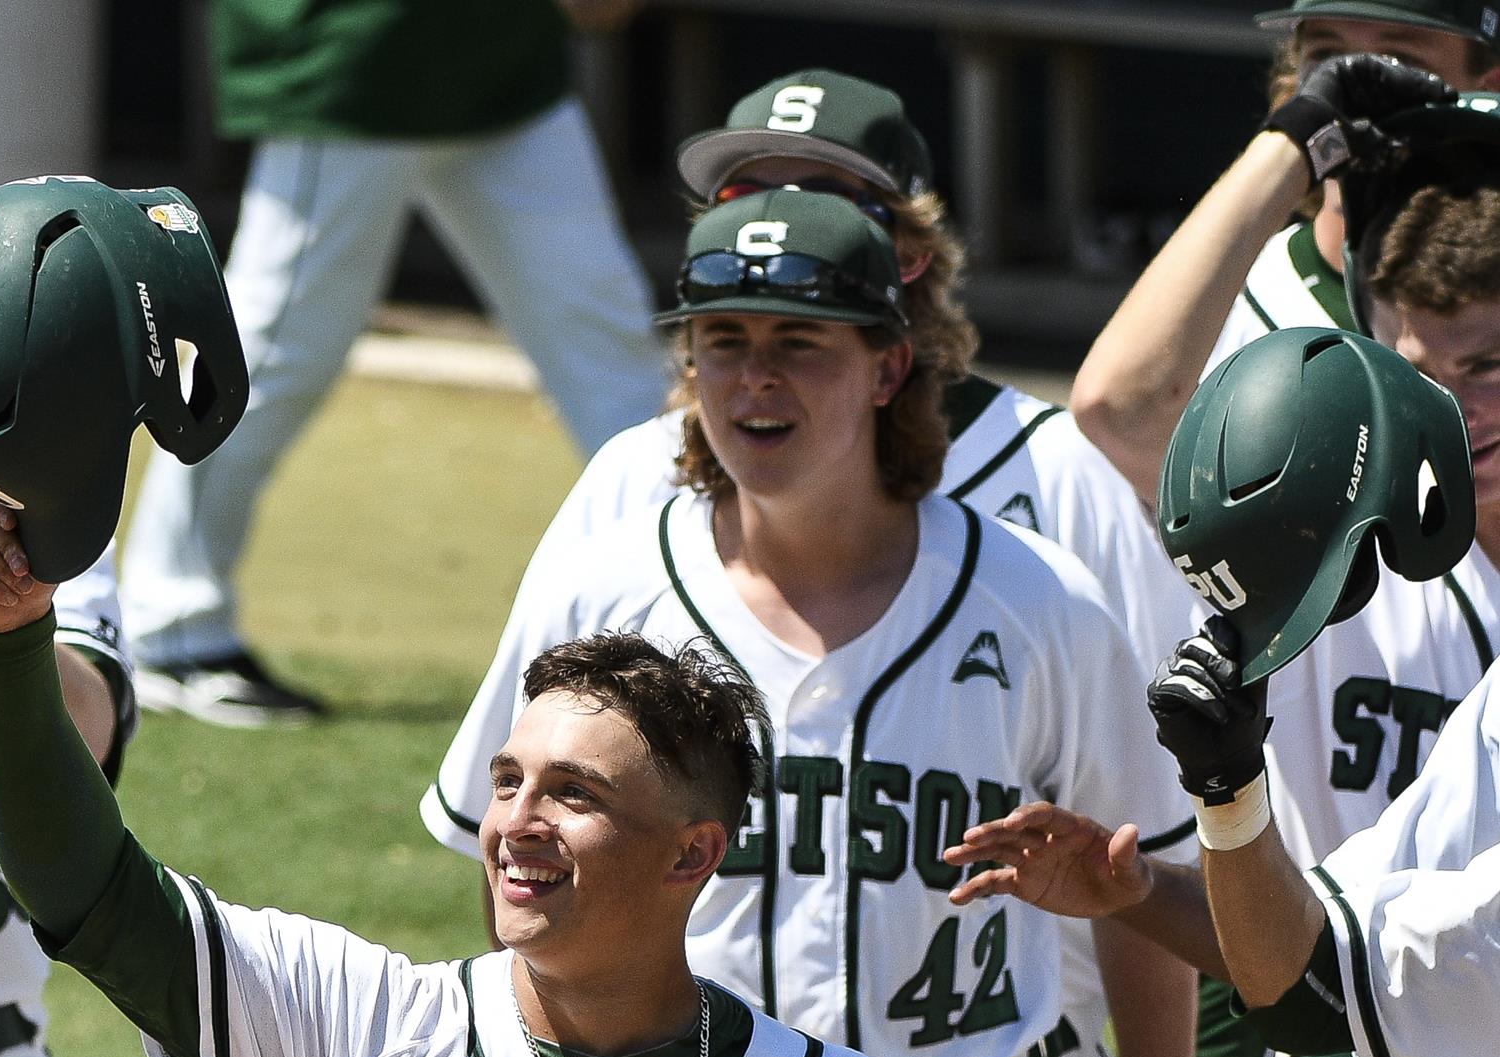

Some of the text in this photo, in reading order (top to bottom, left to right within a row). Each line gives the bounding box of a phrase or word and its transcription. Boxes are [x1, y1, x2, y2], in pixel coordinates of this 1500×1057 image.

[767, 85, 825, 133] S
[136, 281, 162, 358] EASTON
[1346, 424, 1369, 502] EASTON
[1330, 676, 1463, 800] ST
[887, 907, 1021, 1048] 42
